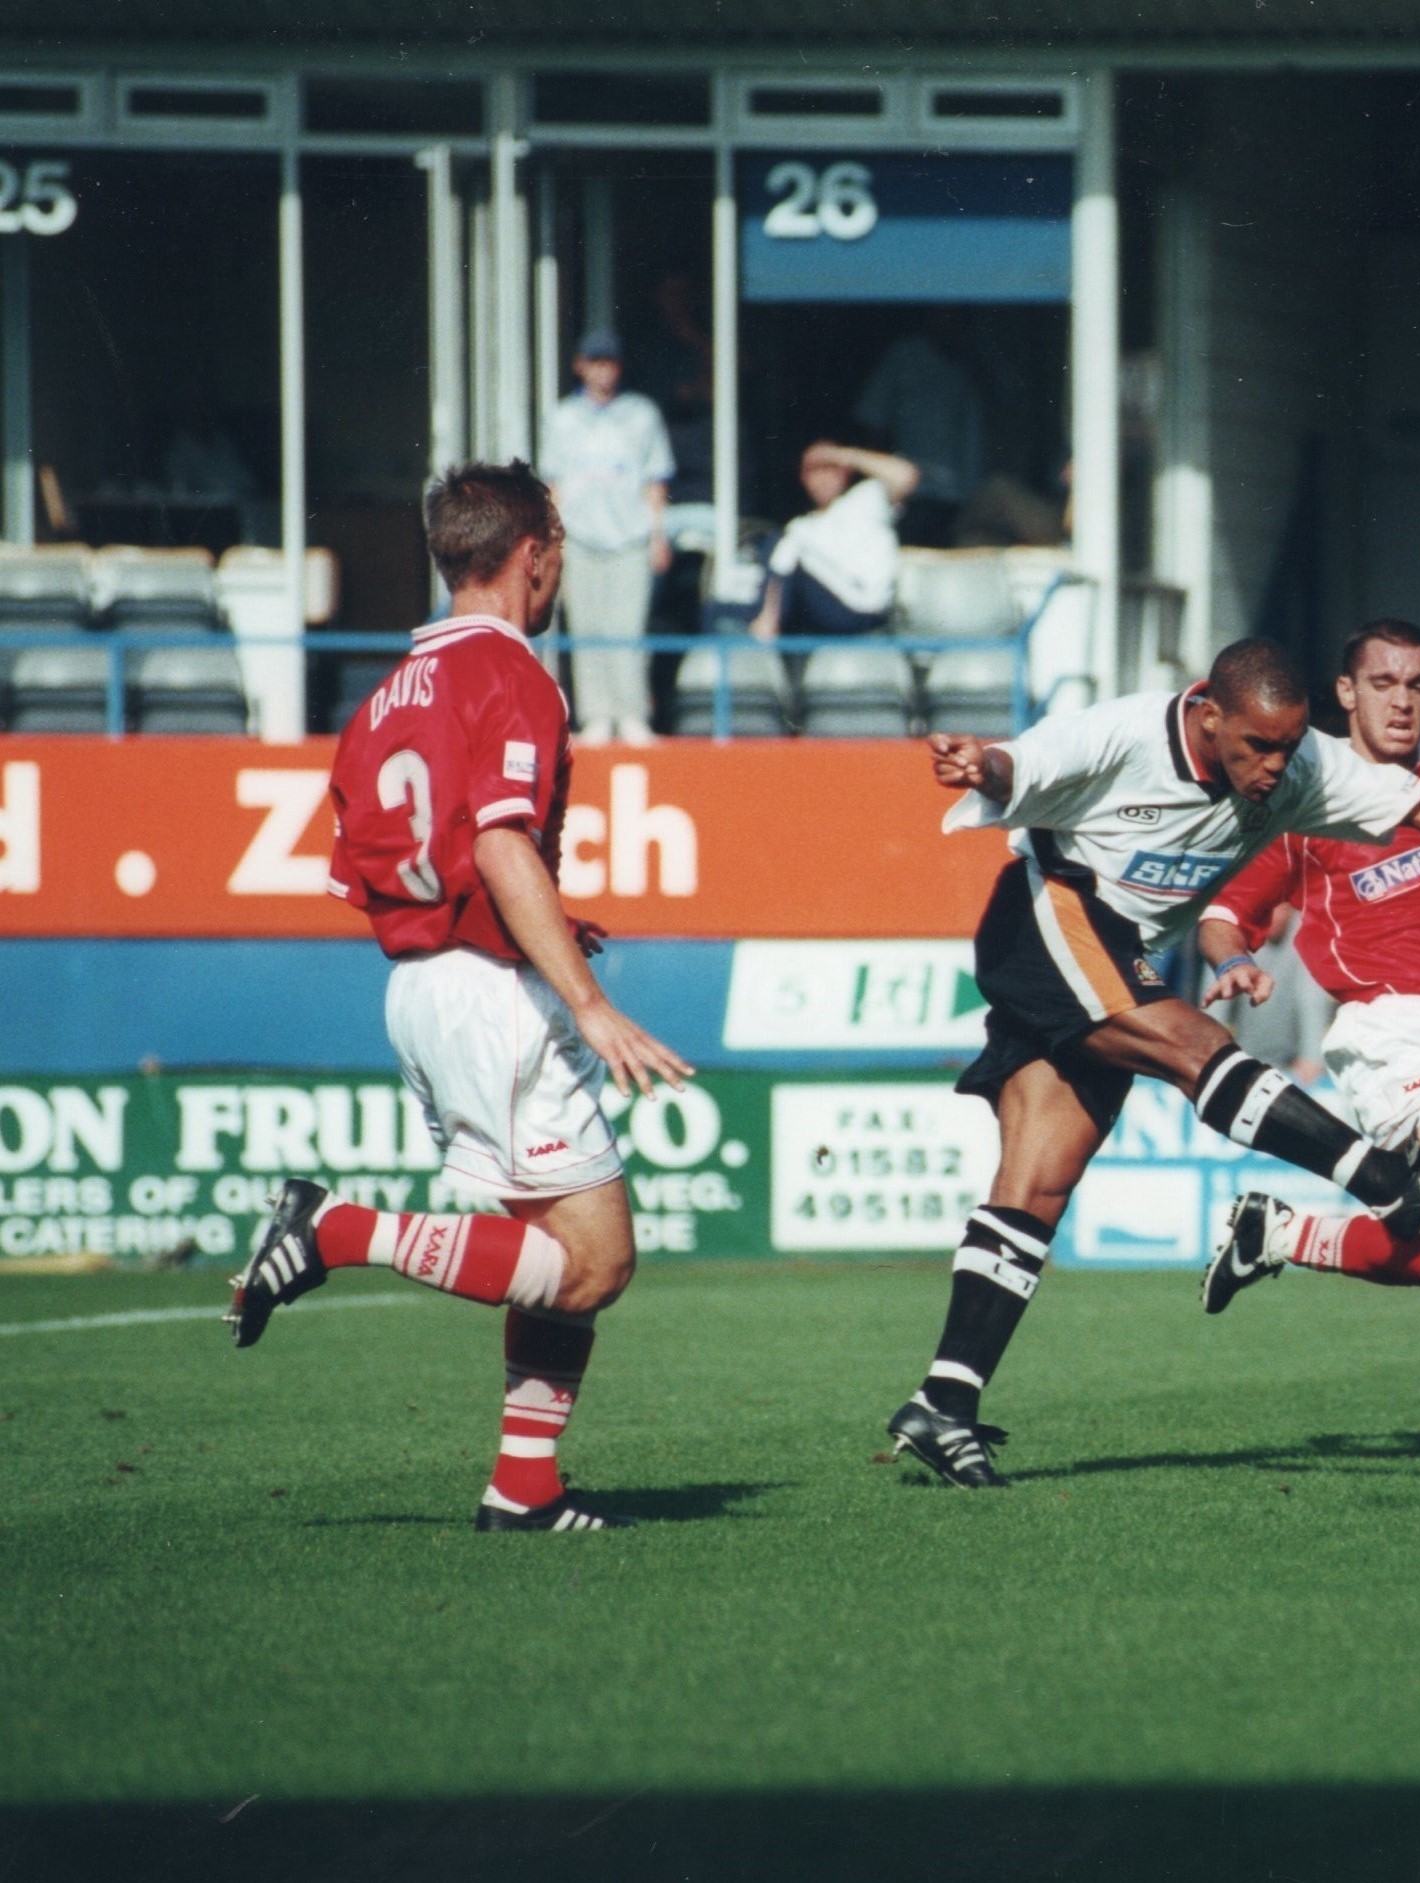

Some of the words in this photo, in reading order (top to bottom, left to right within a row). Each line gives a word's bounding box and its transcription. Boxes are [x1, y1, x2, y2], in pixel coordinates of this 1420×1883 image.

[763, 161, 879, 241] 26
[370, 655, 439, 732] DAVIS
[377, 749, 441, 903] 3
[175, 1085, 442, 1172] FRUI
[525, 1139, 569, 1159] XARA
[809, 1145, 963, 1179] 01582
[129, 1175, 200, 1215] OF
[417, 1225, 449, 1277] XARA
